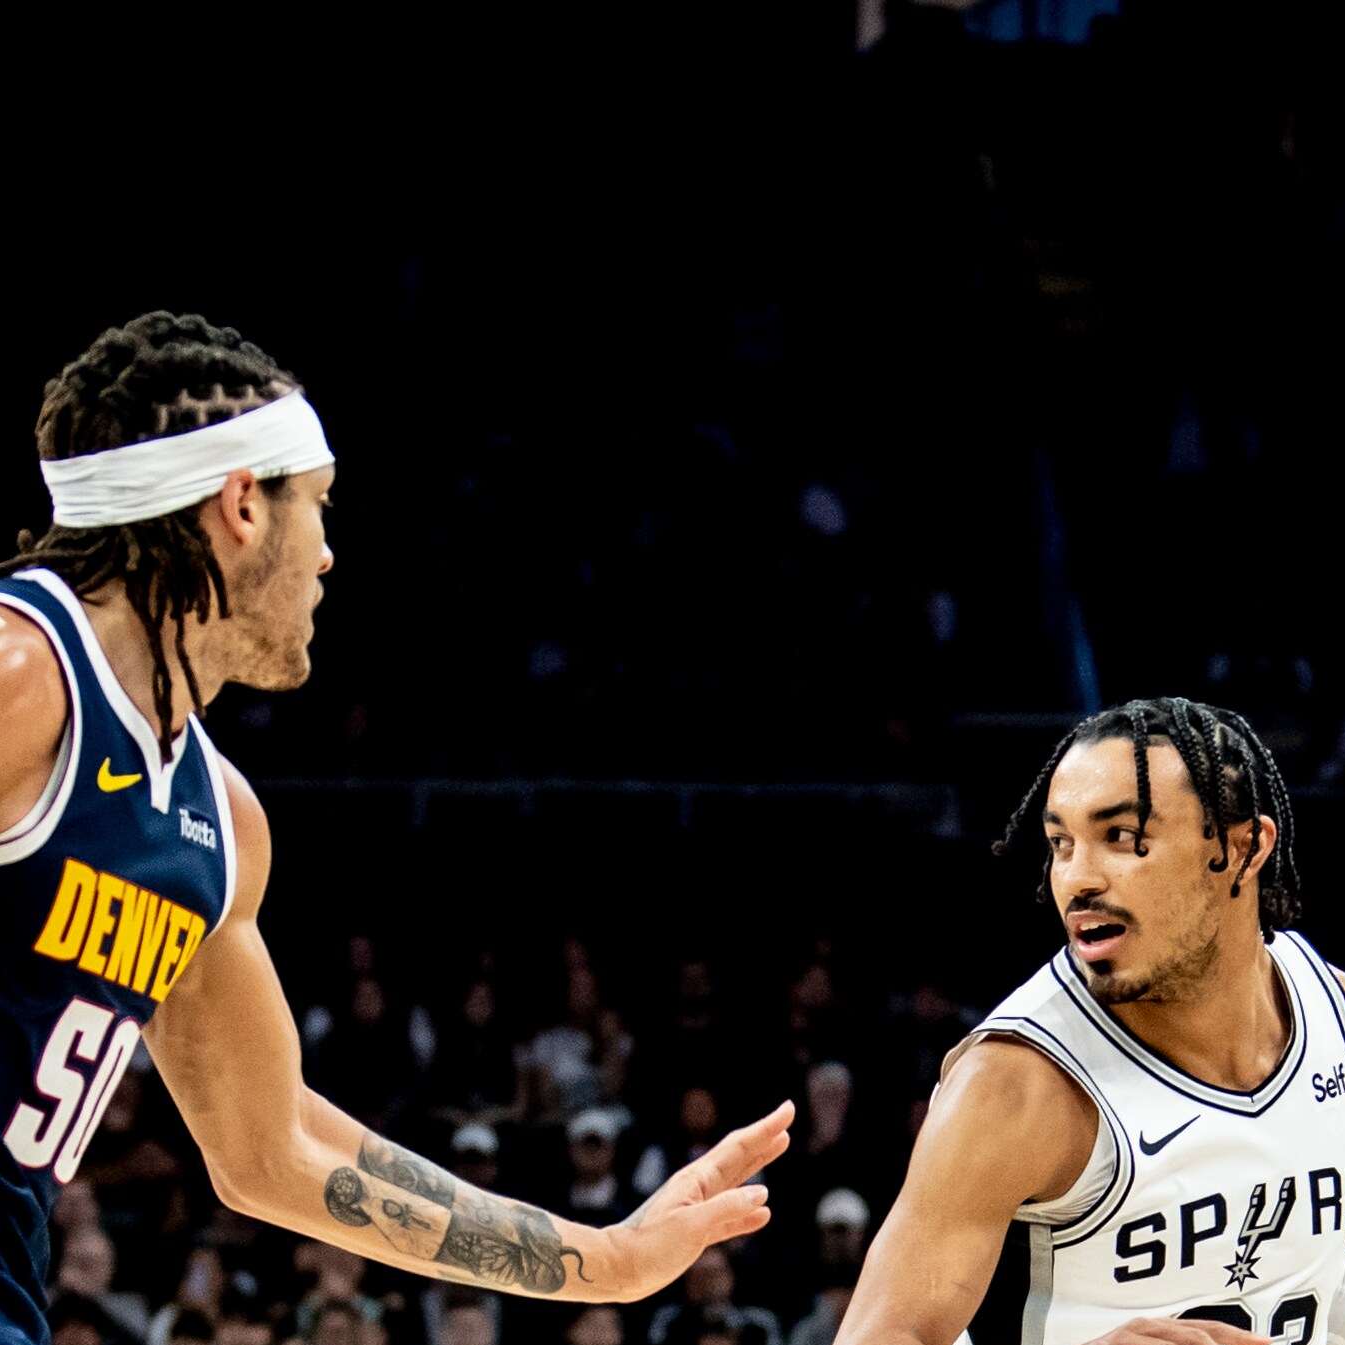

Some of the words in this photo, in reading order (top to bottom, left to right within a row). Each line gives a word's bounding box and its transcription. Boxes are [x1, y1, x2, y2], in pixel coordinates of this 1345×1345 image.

[179, 807, 217, 850] ibotta
[32, 857, 207, 1003] DENVER
[2, 995, 141, 1184] 50
